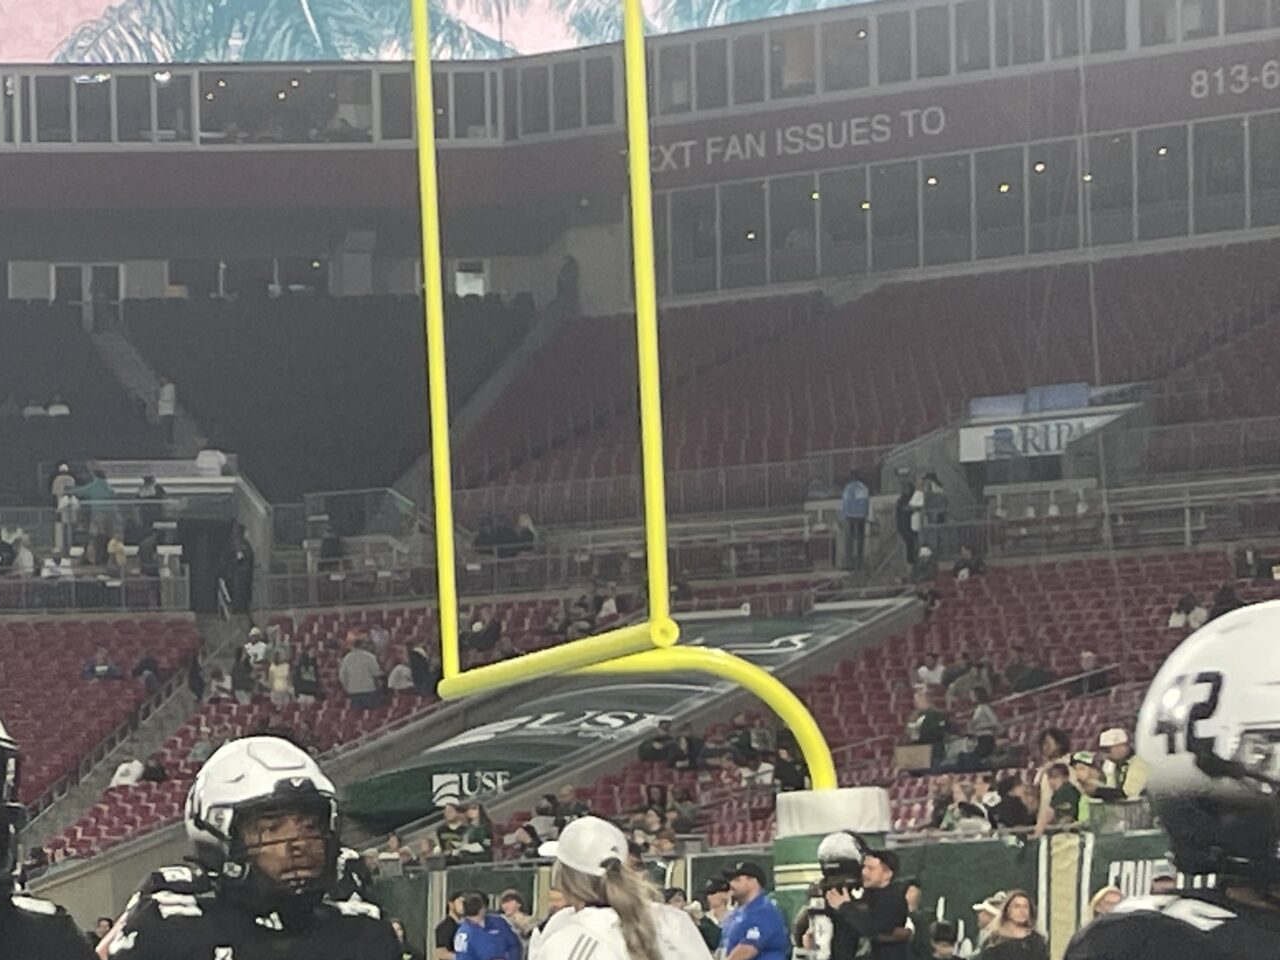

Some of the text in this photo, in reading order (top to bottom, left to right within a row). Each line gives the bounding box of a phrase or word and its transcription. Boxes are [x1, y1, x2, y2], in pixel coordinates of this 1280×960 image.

[1191, 60, 1280, 98] 813-6
[706, 131, 766, 165] FAN
[776, 113, 892, 156] ISSUES
[900, 106, 946, 138] TO
